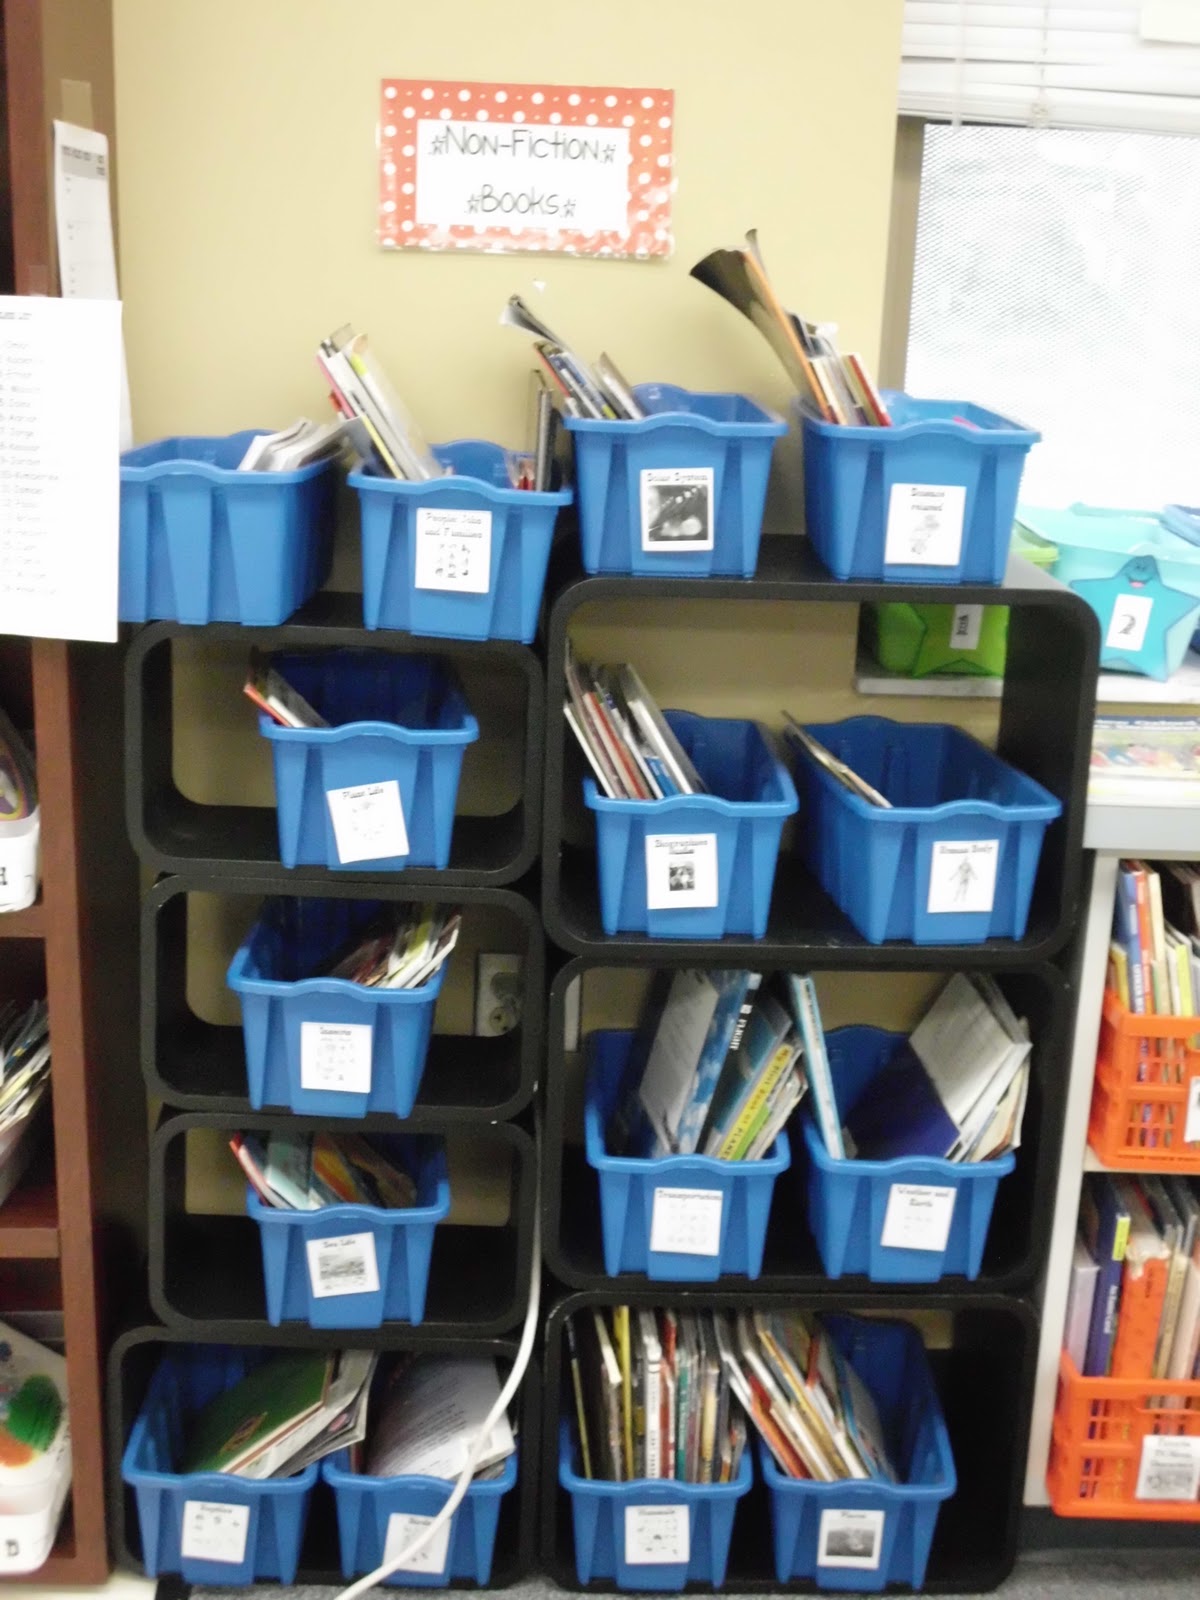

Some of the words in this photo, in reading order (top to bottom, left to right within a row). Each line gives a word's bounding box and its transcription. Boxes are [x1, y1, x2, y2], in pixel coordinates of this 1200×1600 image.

[444, 125, 600, 161] Non-Fiction
[479, 184, 561, 216] Books
[1118, 613, 1137, 635] 2
